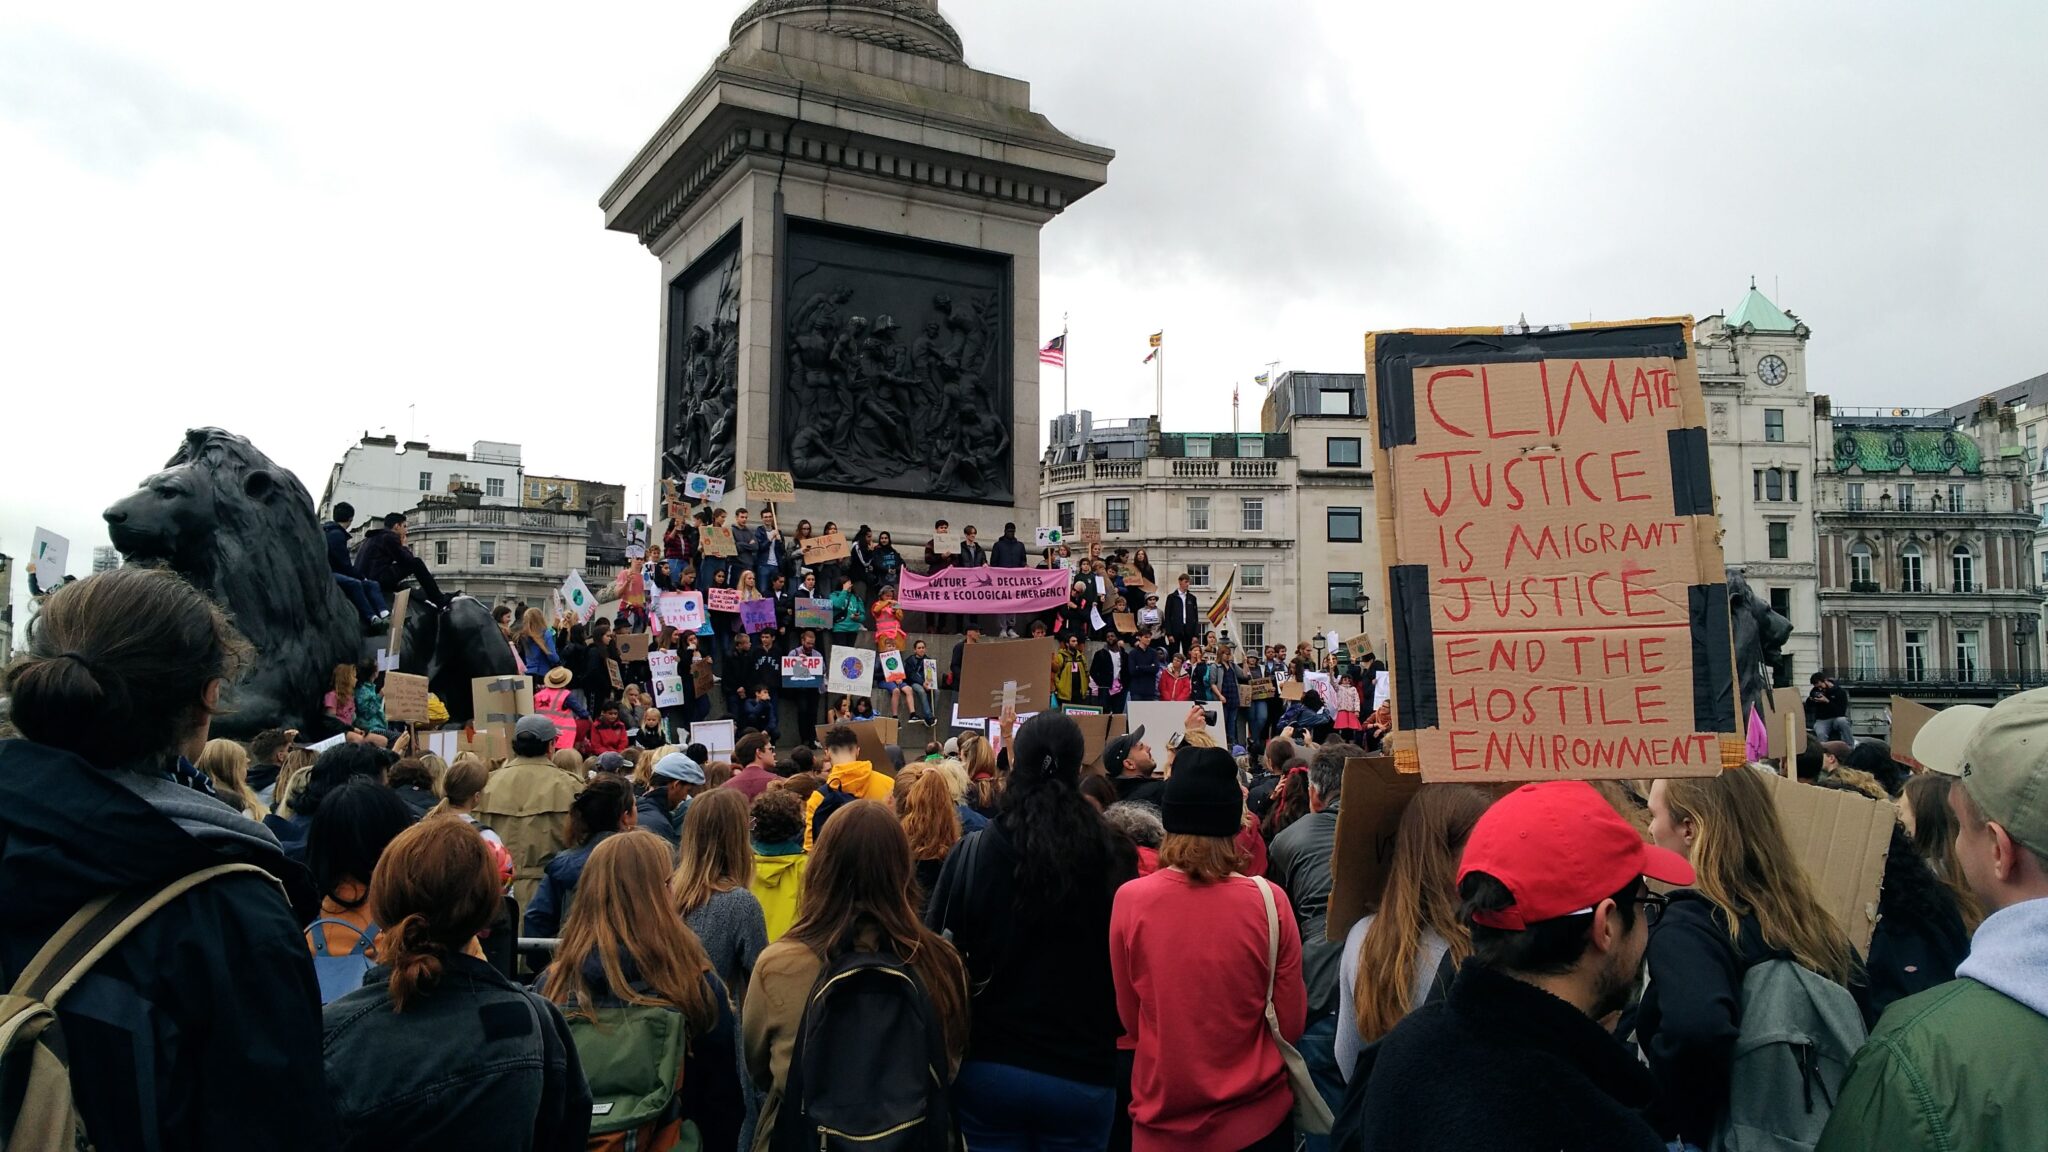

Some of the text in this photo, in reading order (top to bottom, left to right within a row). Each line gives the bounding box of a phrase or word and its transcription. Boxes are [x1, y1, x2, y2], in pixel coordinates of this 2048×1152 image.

[1426, 359, 1680, 438] CLIMATE
[744, 471, 787, 482] SWIMMING
[746, 480, 793, 493] LESSONS
[1415, 450, 1653, 516] JUSTICE
[1439, 522, 1685, 572] IS MIGRANT
[943, 590, 950, 600] &
[953, 590, 1012, 600] ECOLOGICAL
[1016, 586, 1067, 599] EMERGENCY
[997, 576, 1043, 587] DECLARES
[1438, 569, 1665, 622] JUSTICE
[667, 613, 697, 624] LANET
[783, 658, 820, 668] NO CAP
[1446, 636, 1666, 677] END THE
[1449, 685, 1669, 725] HOSTILE
[1450, 730, 1716, 772] ENVIRONMENT
